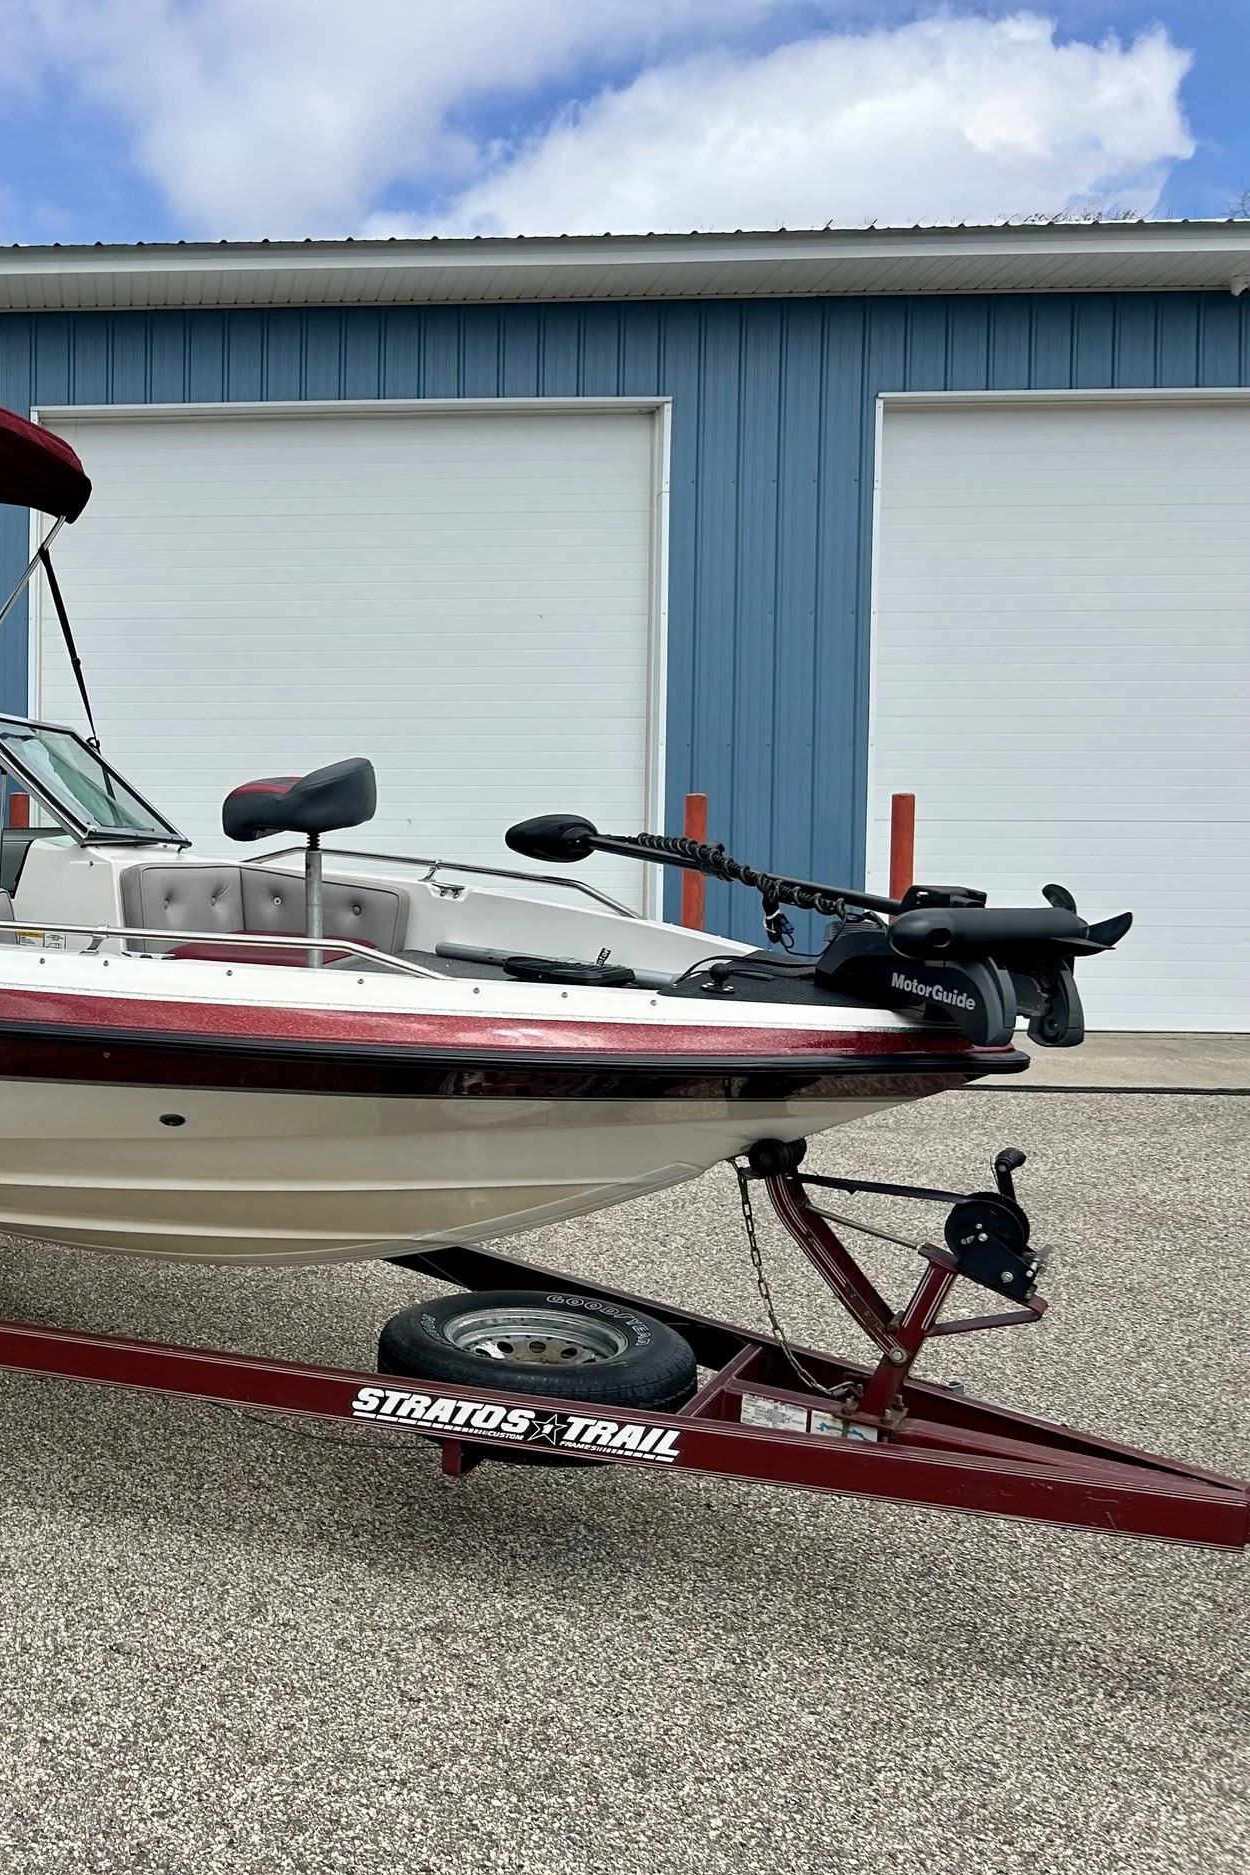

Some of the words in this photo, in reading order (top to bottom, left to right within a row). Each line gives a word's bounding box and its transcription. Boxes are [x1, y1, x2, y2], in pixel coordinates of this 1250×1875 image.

[891, 971, 976, 1011] MotorGuide
[352, 1386, 536, 1434] STRATOS
[563, 1415, 681, 1457] TRAIL
[488, 1430, 525, 1441] CUSTOM
[559, 1440, 598, 1451] FRAMES
